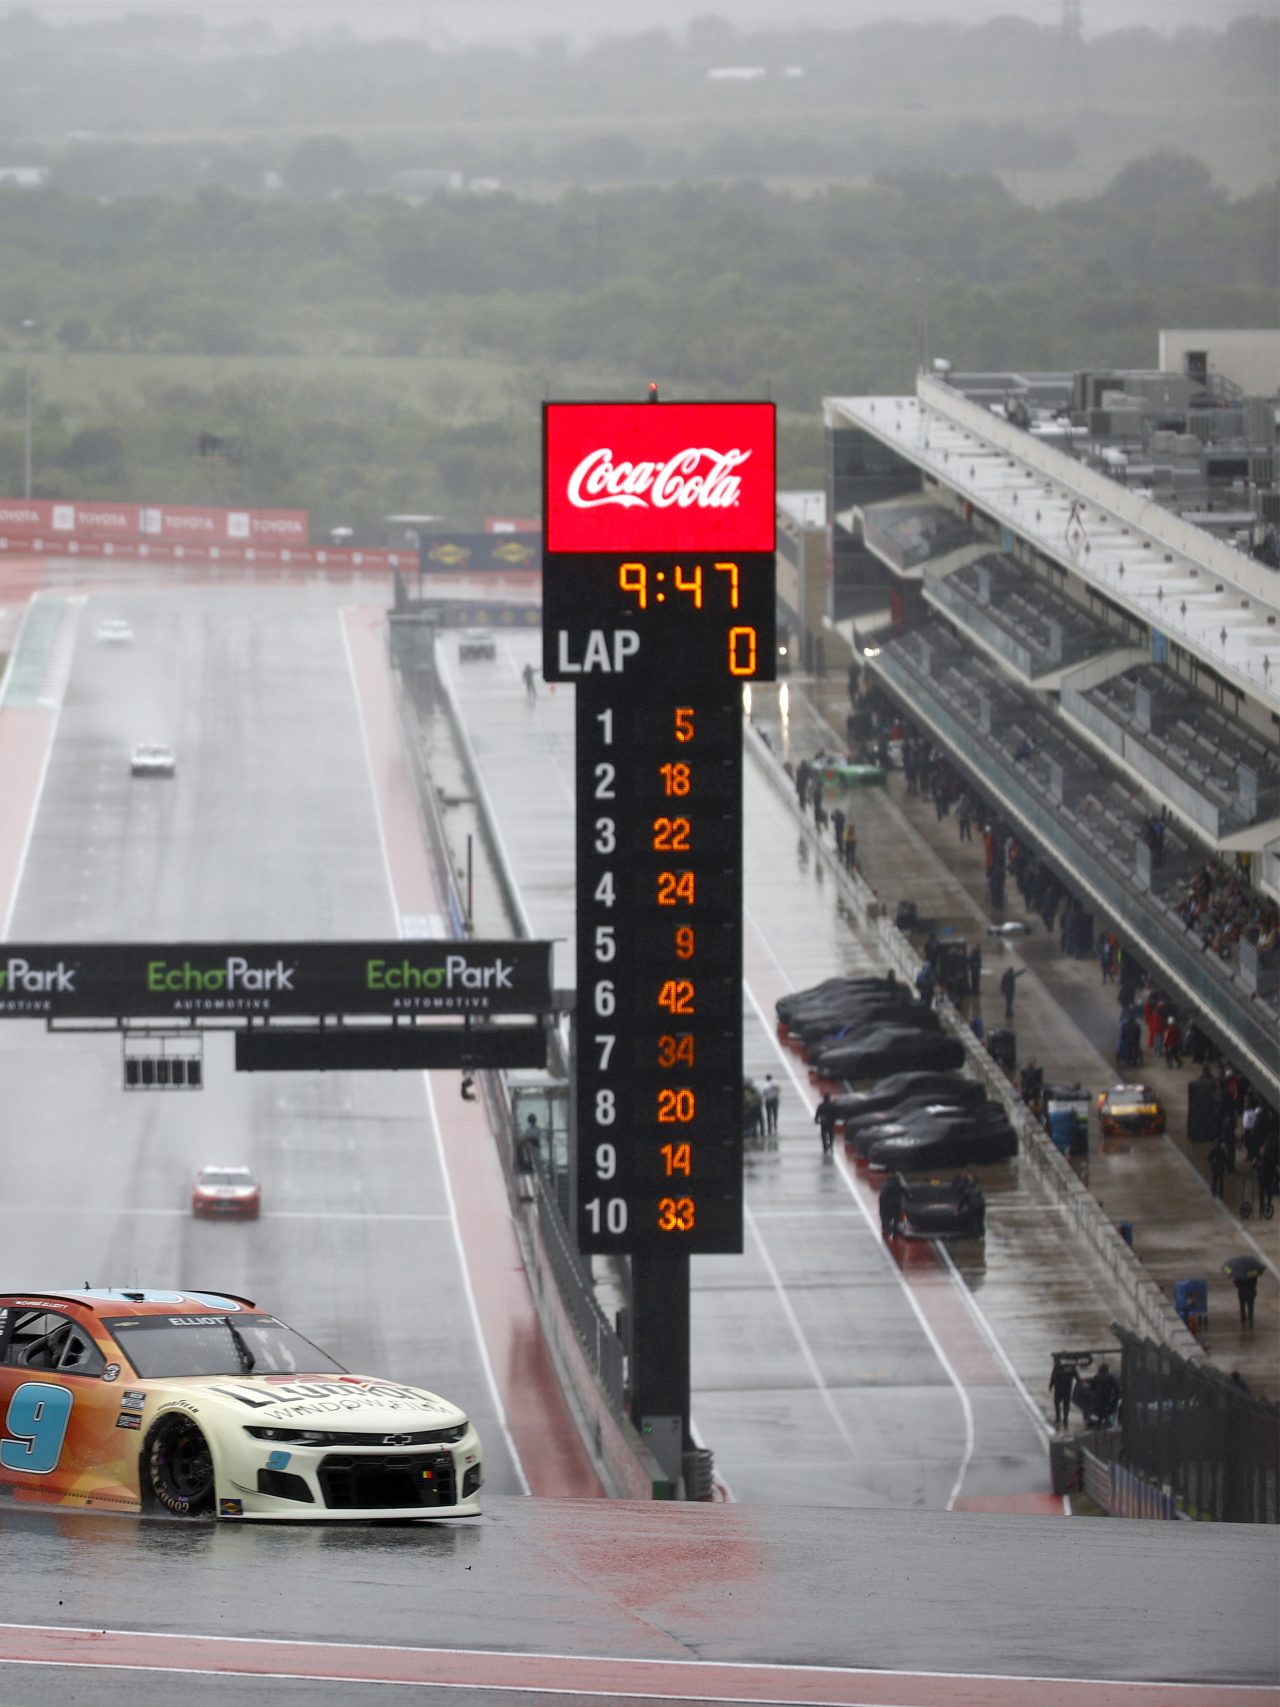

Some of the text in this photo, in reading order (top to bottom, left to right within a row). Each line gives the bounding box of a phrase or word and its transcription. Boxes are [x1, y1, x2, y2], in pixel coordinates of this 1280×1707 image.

[567, 448, 752, 508] Coca-Cola
[79, 512, 127, 526] TOYOTA
[165, 515, 215, 529] TOYOTA
[253, 520, 302, 533] TOYOTA
[619, 562, 739, 609] 9:47
[558, 626, 757, 676] LAP 0
[597, 707, 695, 745] 1 5
[594, 762, 691, 799] 2 18
[594, 816, 691, 854] 3 22
[594, 871, 695, 907] 4 24
[594, 925, 695, 963] 5 9
[147, 956, 295, 991] EchoPark
[366, 955, 514, 990] EchoPark
[174, 999, 271, 1009] AUTOMOTIVE
[393, 997, 490, 1007] AUTOMOTIVE
[594, 979, 695, 1017] 6 42
[594, 1034, 695, 1071] 7 34
[595, 1088, 695, 1125] 8 20
[595, 1143, 691, 1180] 9 14
[585, 1196, 695, 1234] 10 33
[265, 1450, 292, 1470] 9
